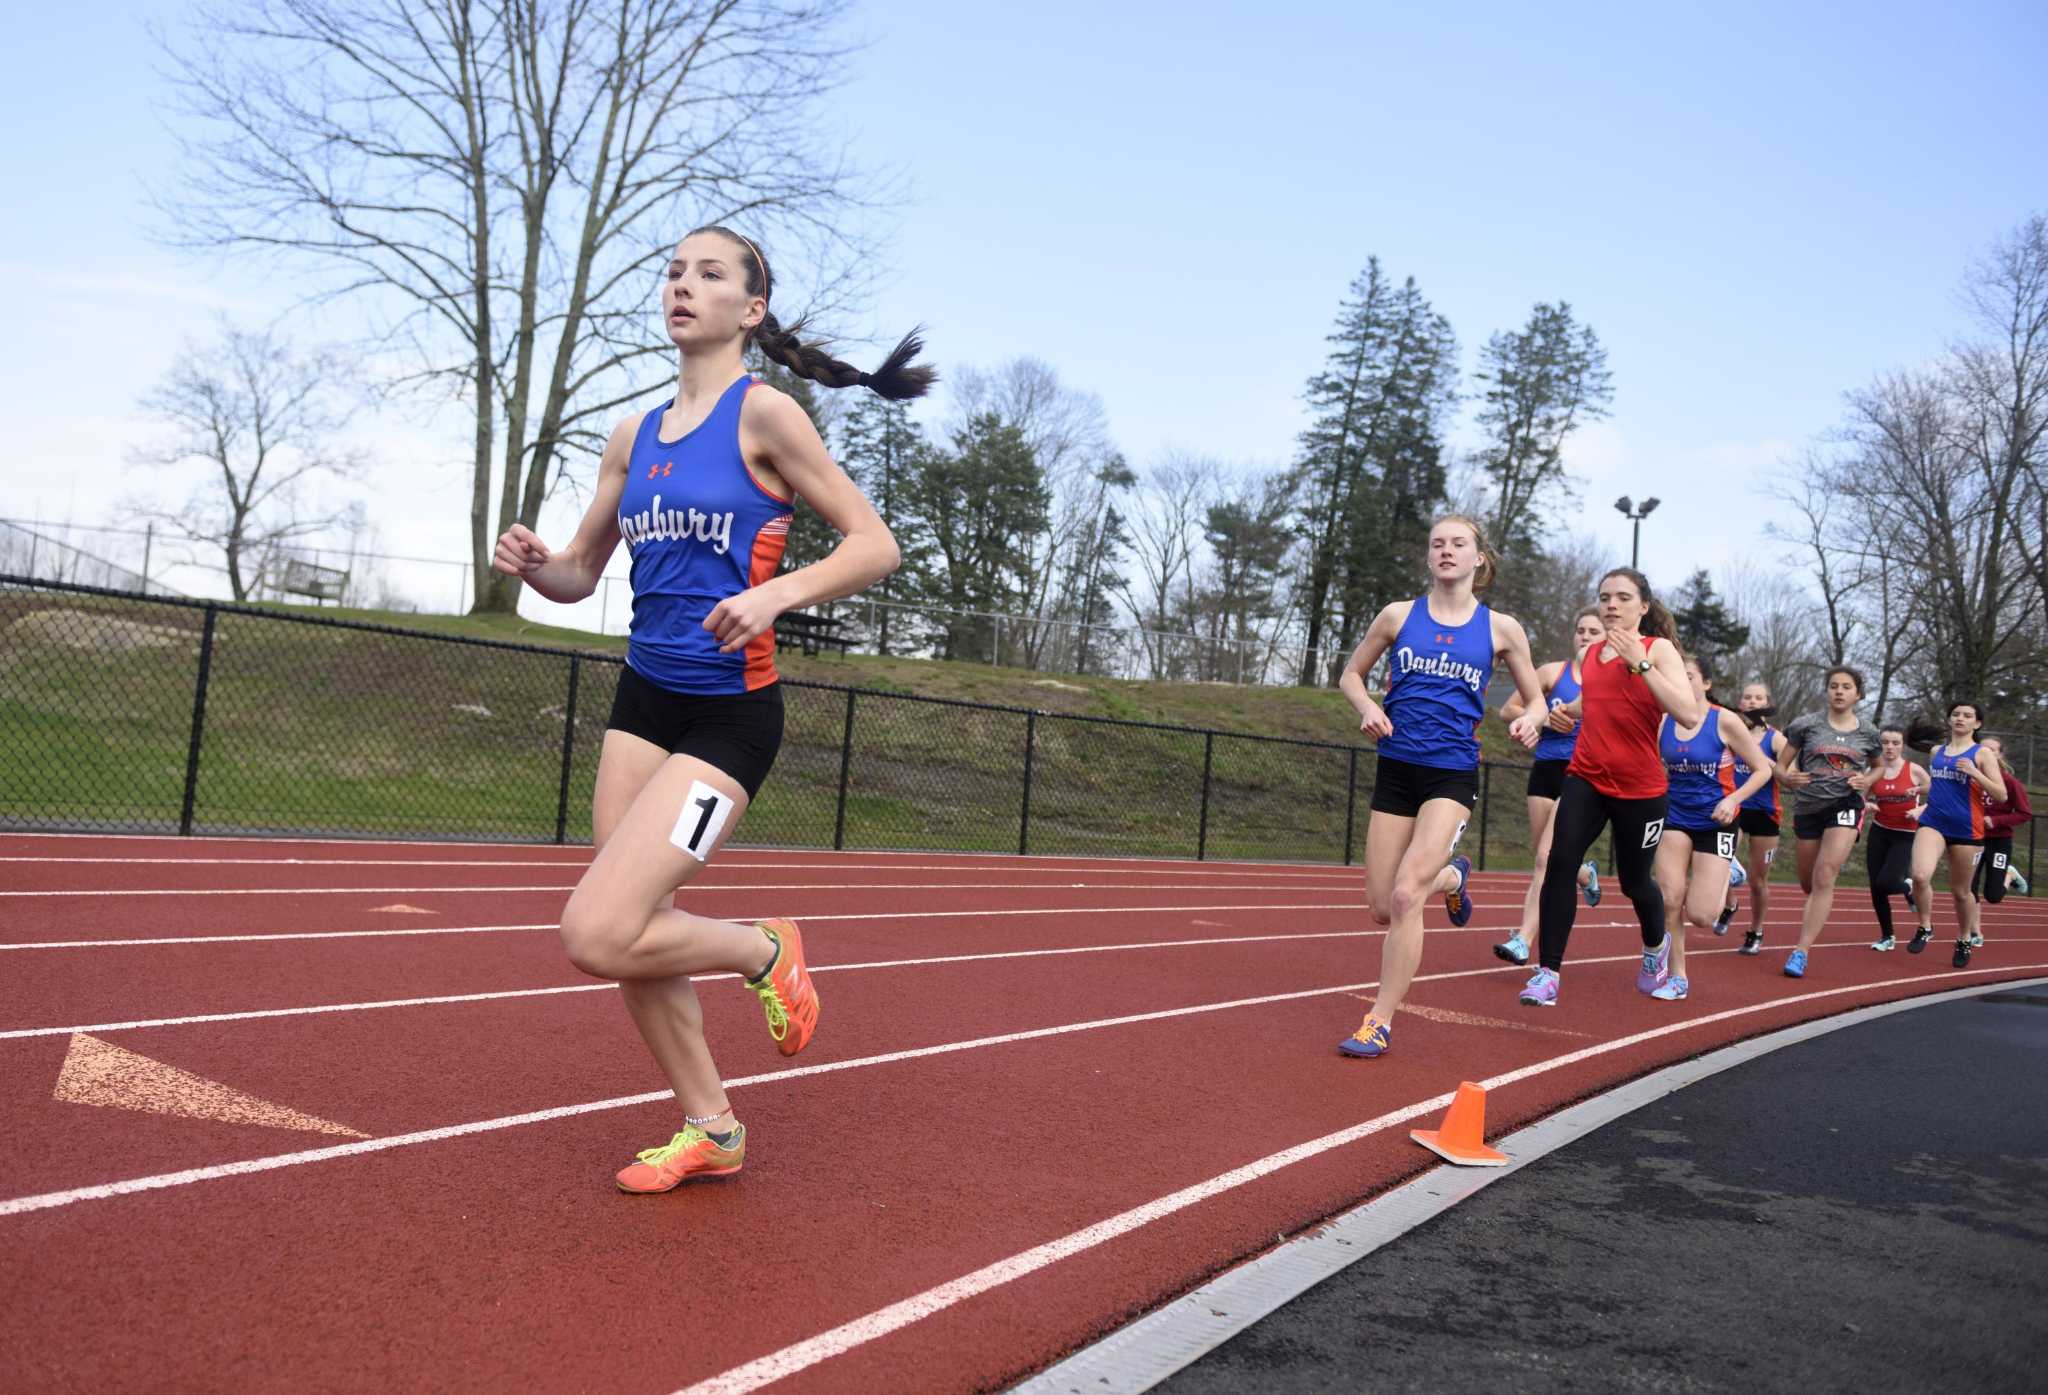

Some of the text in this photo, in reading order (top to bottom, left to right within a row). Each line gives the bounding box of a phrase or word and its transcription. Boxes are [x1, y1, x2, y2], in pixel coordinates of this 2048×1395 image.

[618, 494, 734, 555] anbury
[1397, 646, 1483, 692] Danbury
[686, 795, 719, 851] 1
[1645, 822, 1660, 846] 2
[1720, 834, 1731, 855] 5
[1995, 854, 2005, 867] 9
